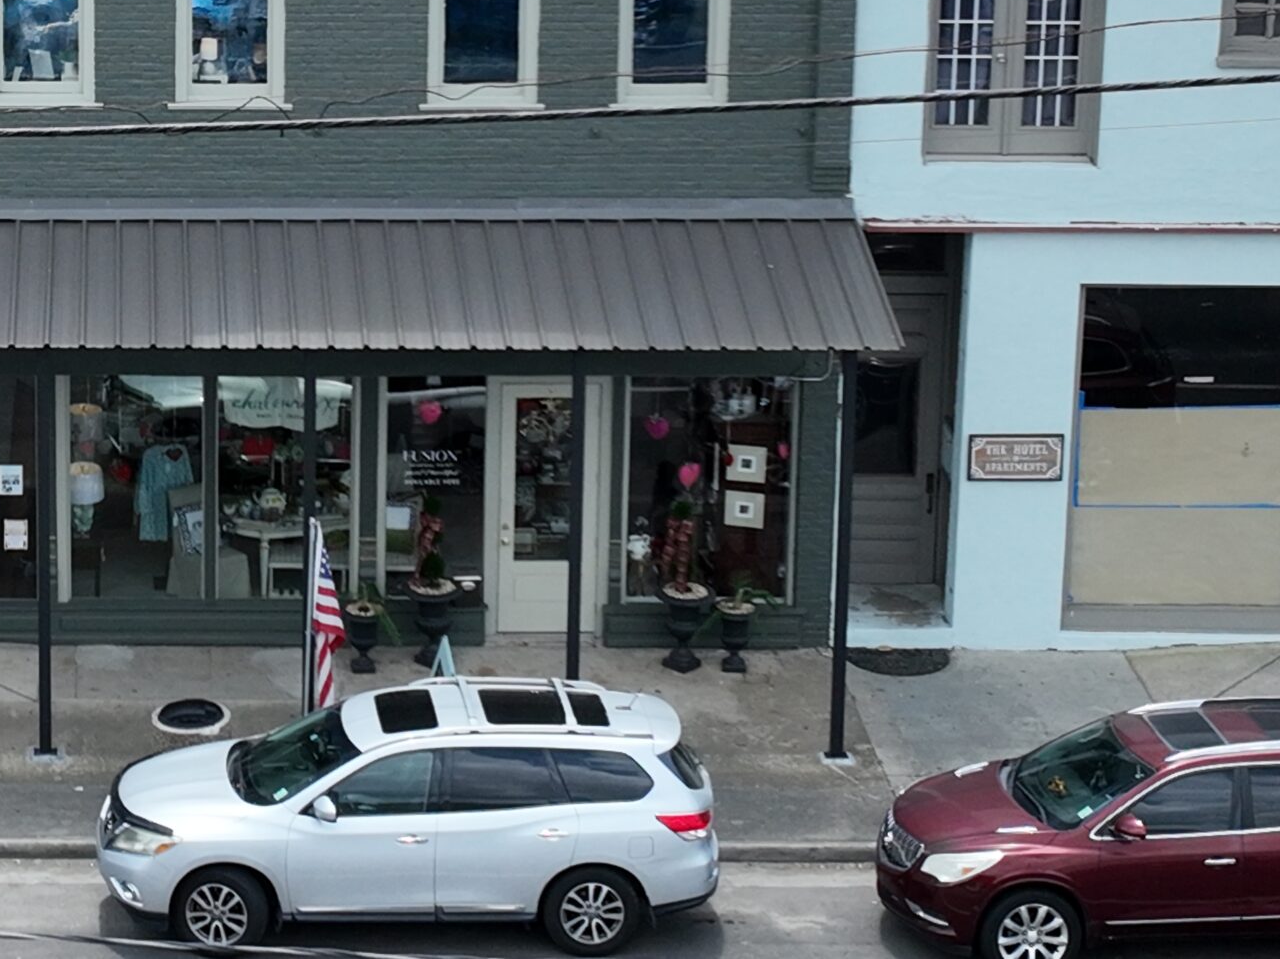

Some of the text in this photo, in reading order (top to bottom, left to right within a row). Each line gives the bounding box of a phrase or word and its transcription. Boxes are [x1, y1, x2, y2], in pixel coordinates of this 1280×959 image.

[985, 444, 1049, 455] THE HOTEL
[984, 462, 1048, 472] APARTMENTS
